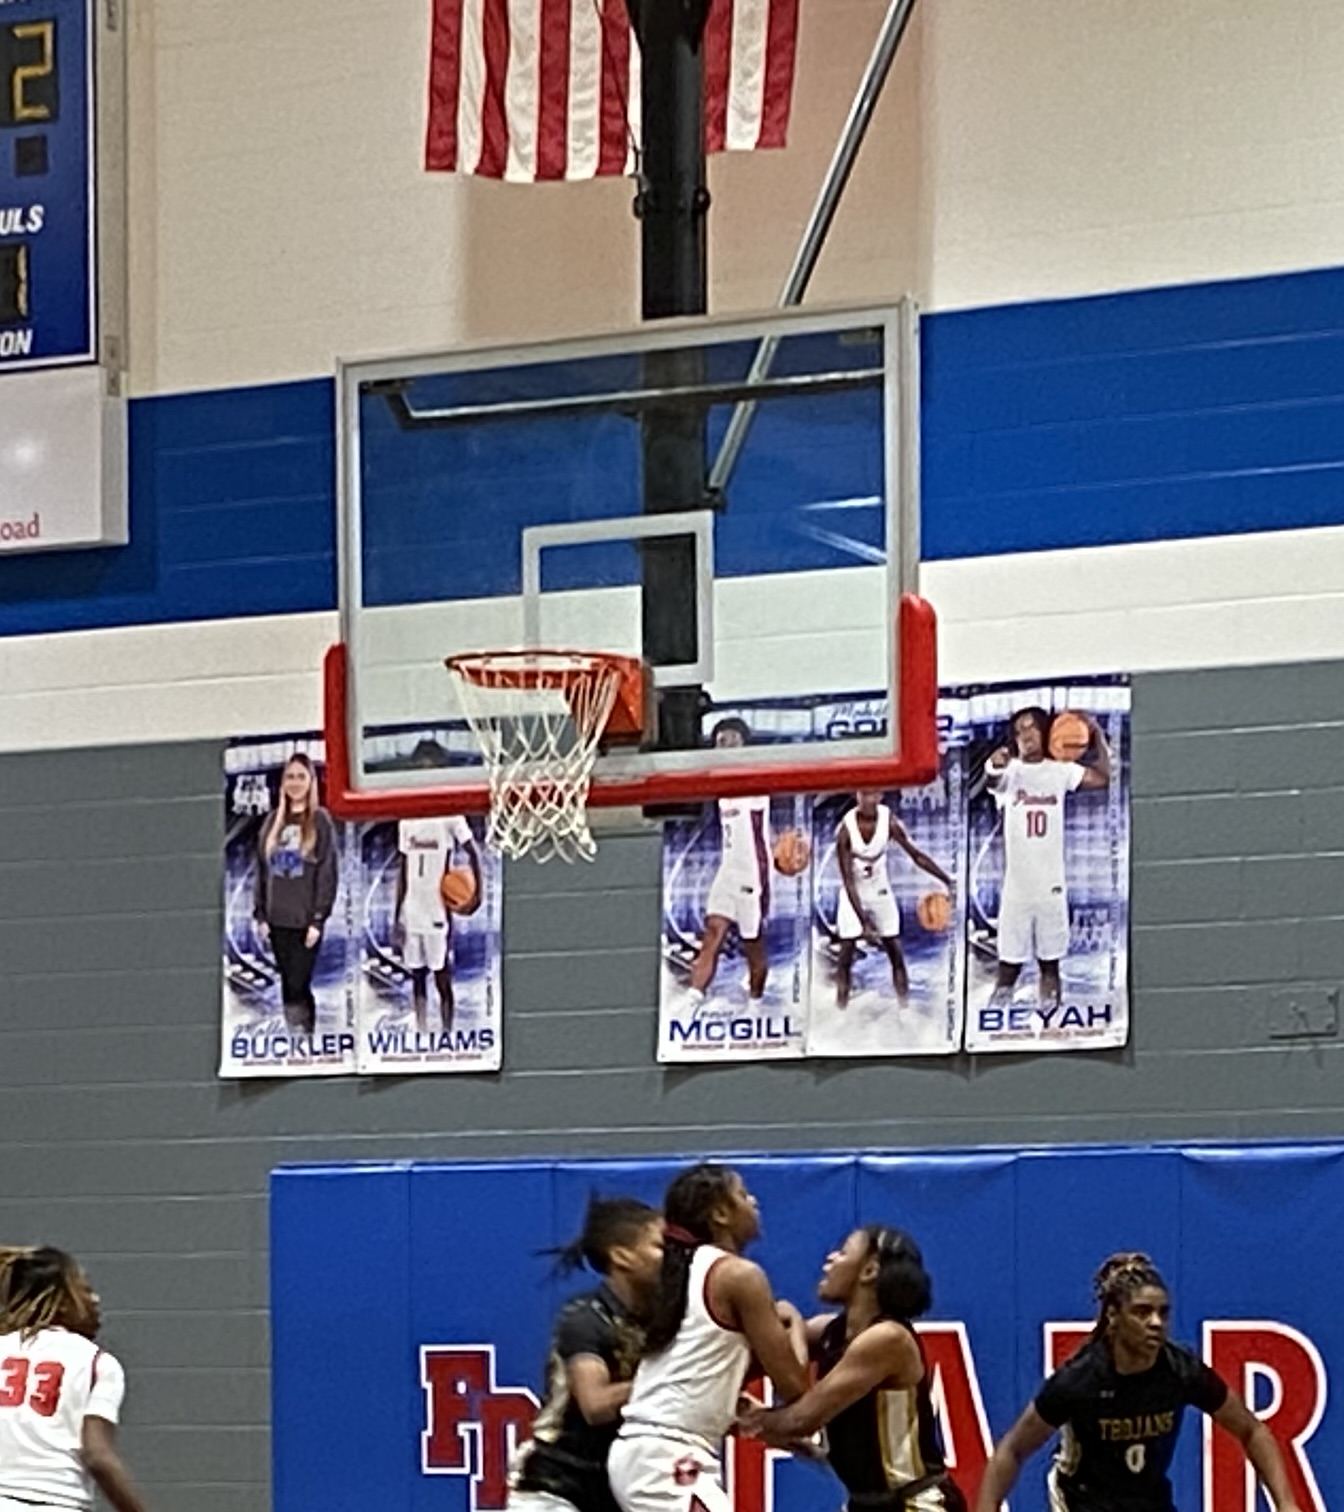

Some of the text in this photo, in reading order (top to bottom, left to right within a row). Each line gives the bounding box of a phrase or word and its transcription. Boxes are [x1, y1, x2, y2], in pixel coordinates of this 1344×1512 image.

[13, 21, 54, 121] 2
[1025, 810, 1048, 839] 10
[978, 1004, 1113, 1032] BEYAH
[368, 1029, 495, 1055] WILLIAMS
